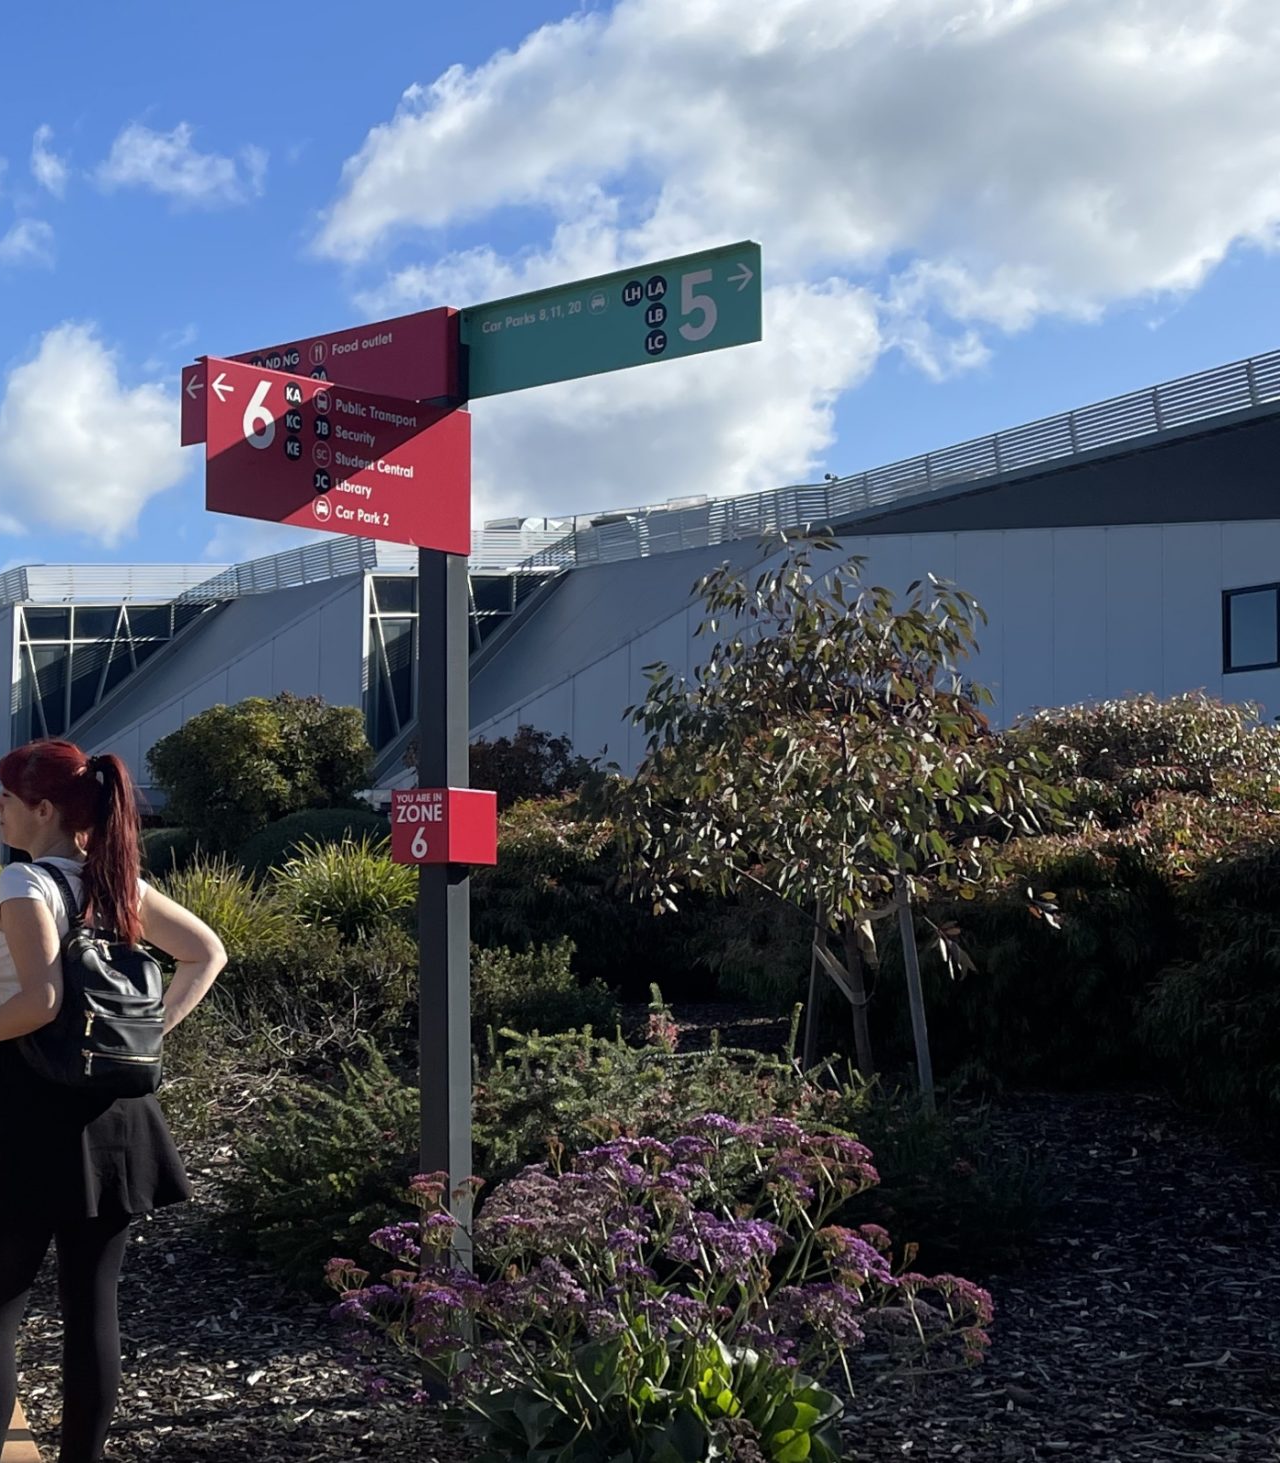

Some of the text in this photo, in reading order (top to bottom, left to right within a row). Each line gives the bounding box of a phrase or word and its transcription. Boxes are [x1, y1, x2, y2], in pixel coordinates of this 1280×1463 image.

[625, 281, 665, 302] LH LA
[678, 269, 717, 341] 5
[482, 321, 502, 334] Car
[505, 313, 536, 328] Parks
[648, 309, 663, 323] LB
[331, 333, 392, 356] Food outlet
[648, 335, 664, 350] LC
[283, 353, 300, 366] NG
[285, 387, 302, 404] KA
[242, 380, 276, 450] 6
[286, 413, 302, 430] KC
[335, 399, 417, 428] Public Transport
[316, 421, 329, 435] JB
[335, 425, 375, 448] Security
[287, 442, 300, 457] KE
[335, 452, 414, 478] Student Central
[315, 475, 329, 489] JC
[335, 478, 372, 499] Library
[335, 505, 390, 527] Car Park 2
[396, 792, 442, 803] YOU ARE IN
[396, 804, 442, 823] ZONE
[411, 827, 428, 859] 6
